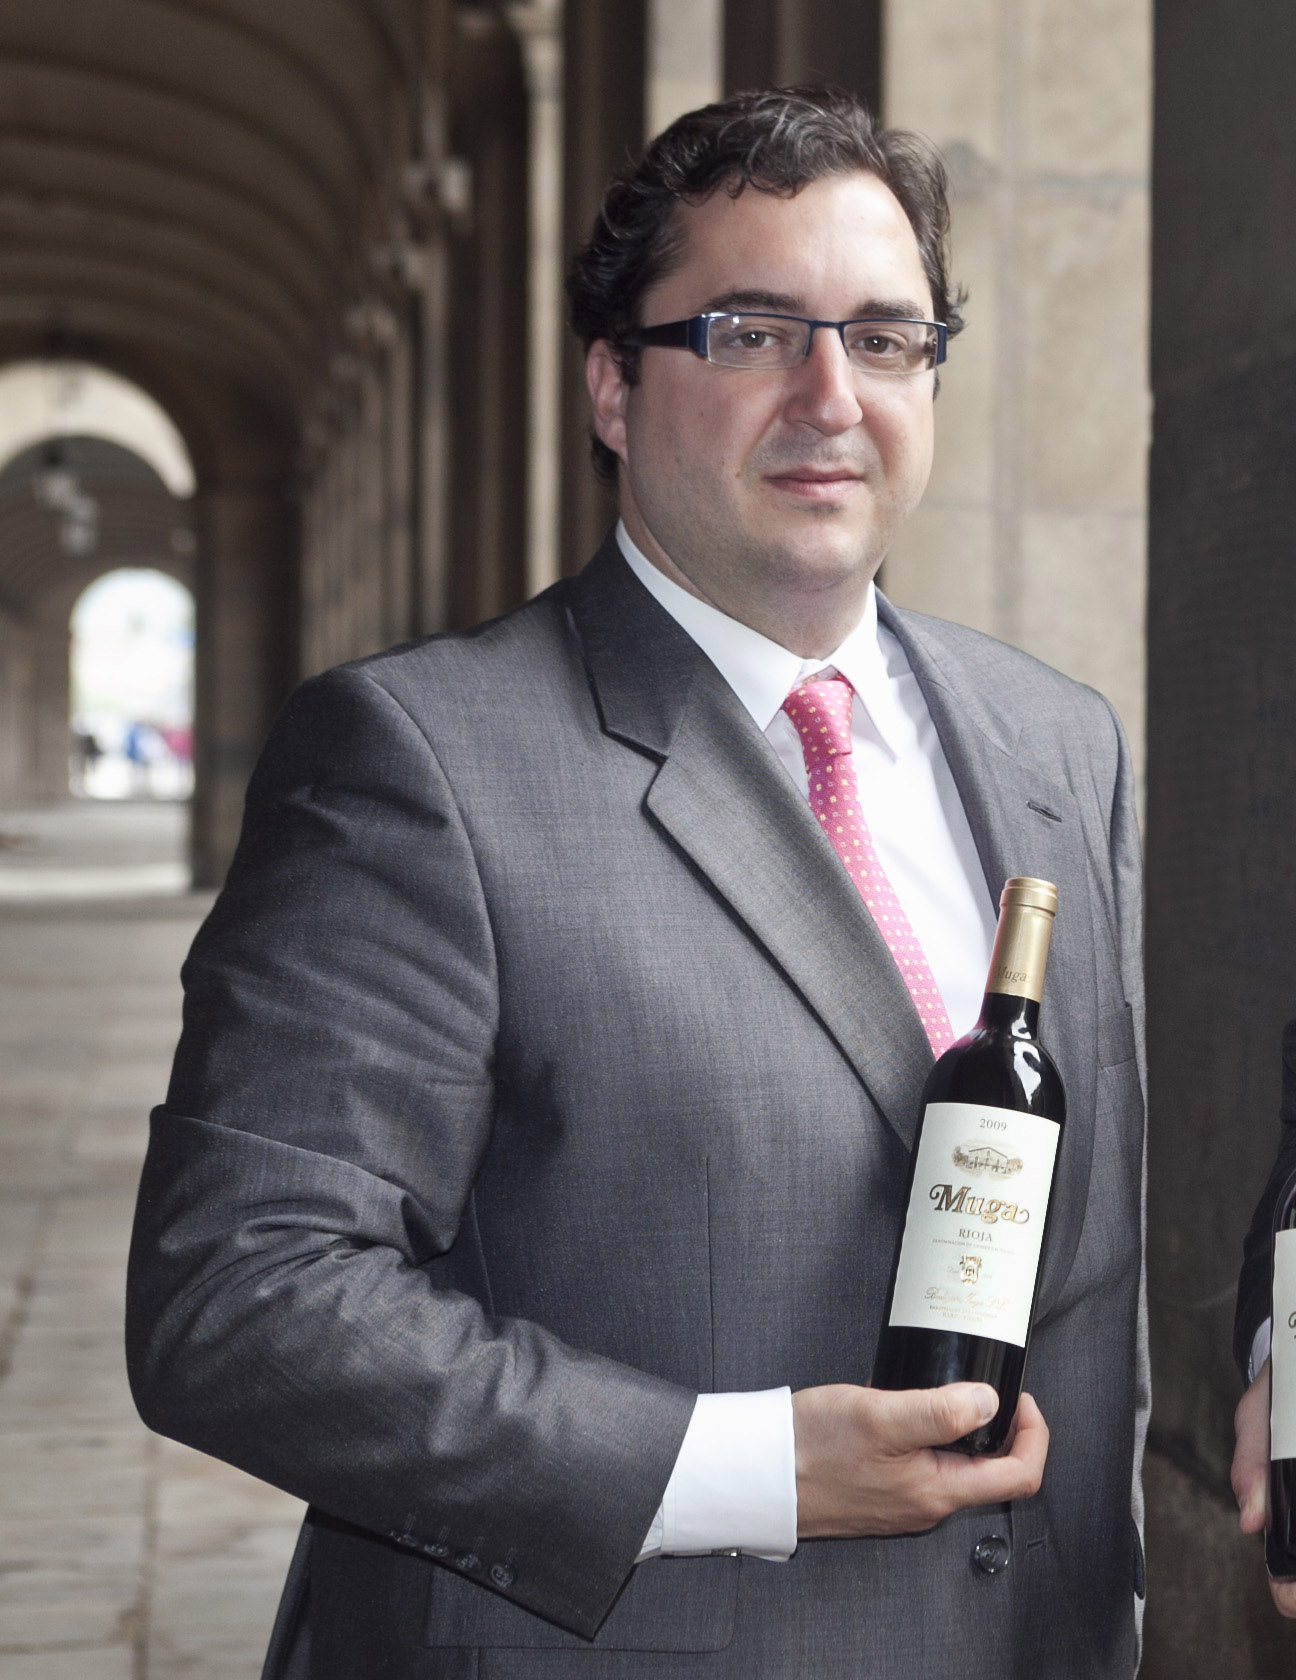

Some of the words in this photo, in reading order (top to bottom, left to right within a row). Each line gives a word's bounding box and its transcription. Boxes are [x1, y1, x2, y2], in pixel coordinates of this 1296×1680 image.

[979, 1118, 1008, 1132] 2009
[929, 1183, 1030, 1225] Muga
[958, 1228, 993, 1243] RIOJA
